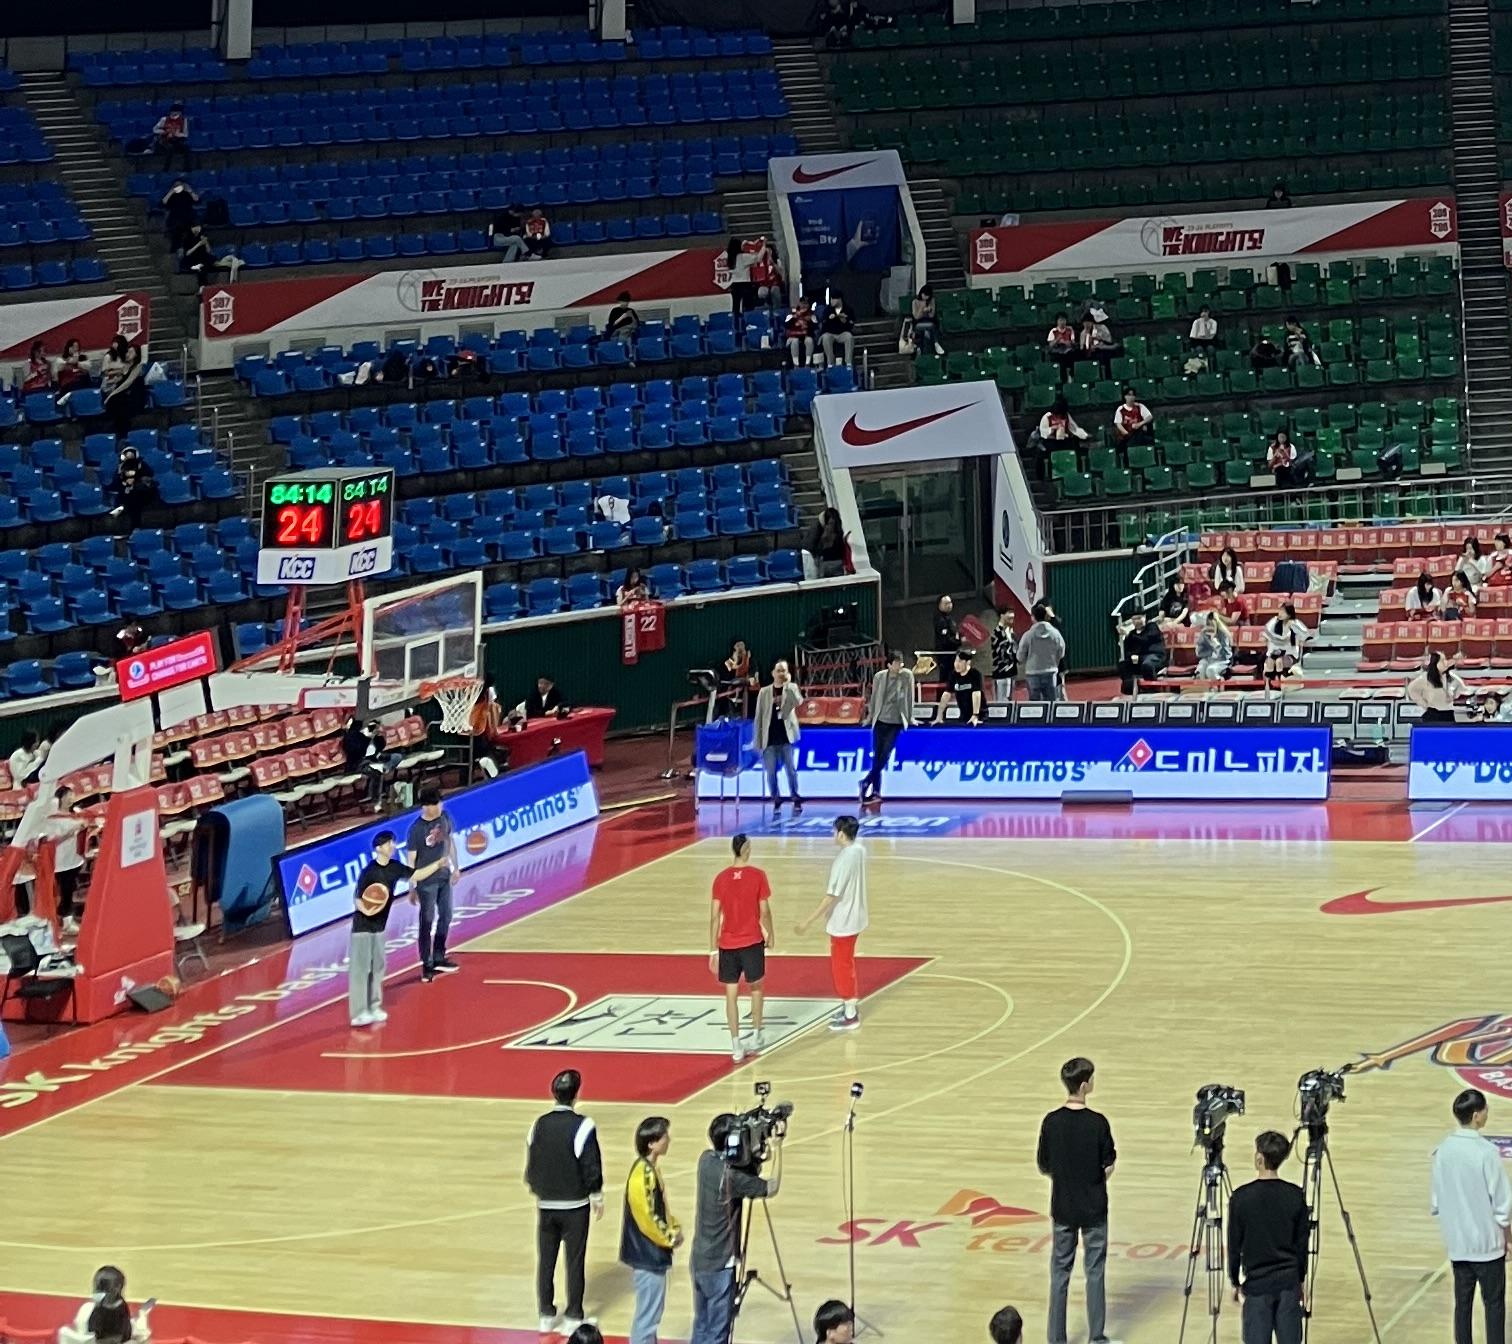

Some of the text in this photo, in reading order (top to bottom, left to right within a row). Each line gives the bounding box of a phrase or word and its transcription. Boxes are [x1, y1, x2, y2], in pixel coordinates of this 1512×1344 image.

[1162, 226, 1185, 243] WE
[1182, 229, 1265, 255] KNIGHTS!
[422, 280, 447, 297] WE
[443, 281, 535, 311] KNIGHTS!
[278, 506, 323, 544] 24
[349, 500, 381, 539] 24
[280, 556, 314, 579] KCC
[351, 548, 376, 574] KCC
[60, 1002, 257, 1073] knights
[815, 1218, 953, 1248] SK
